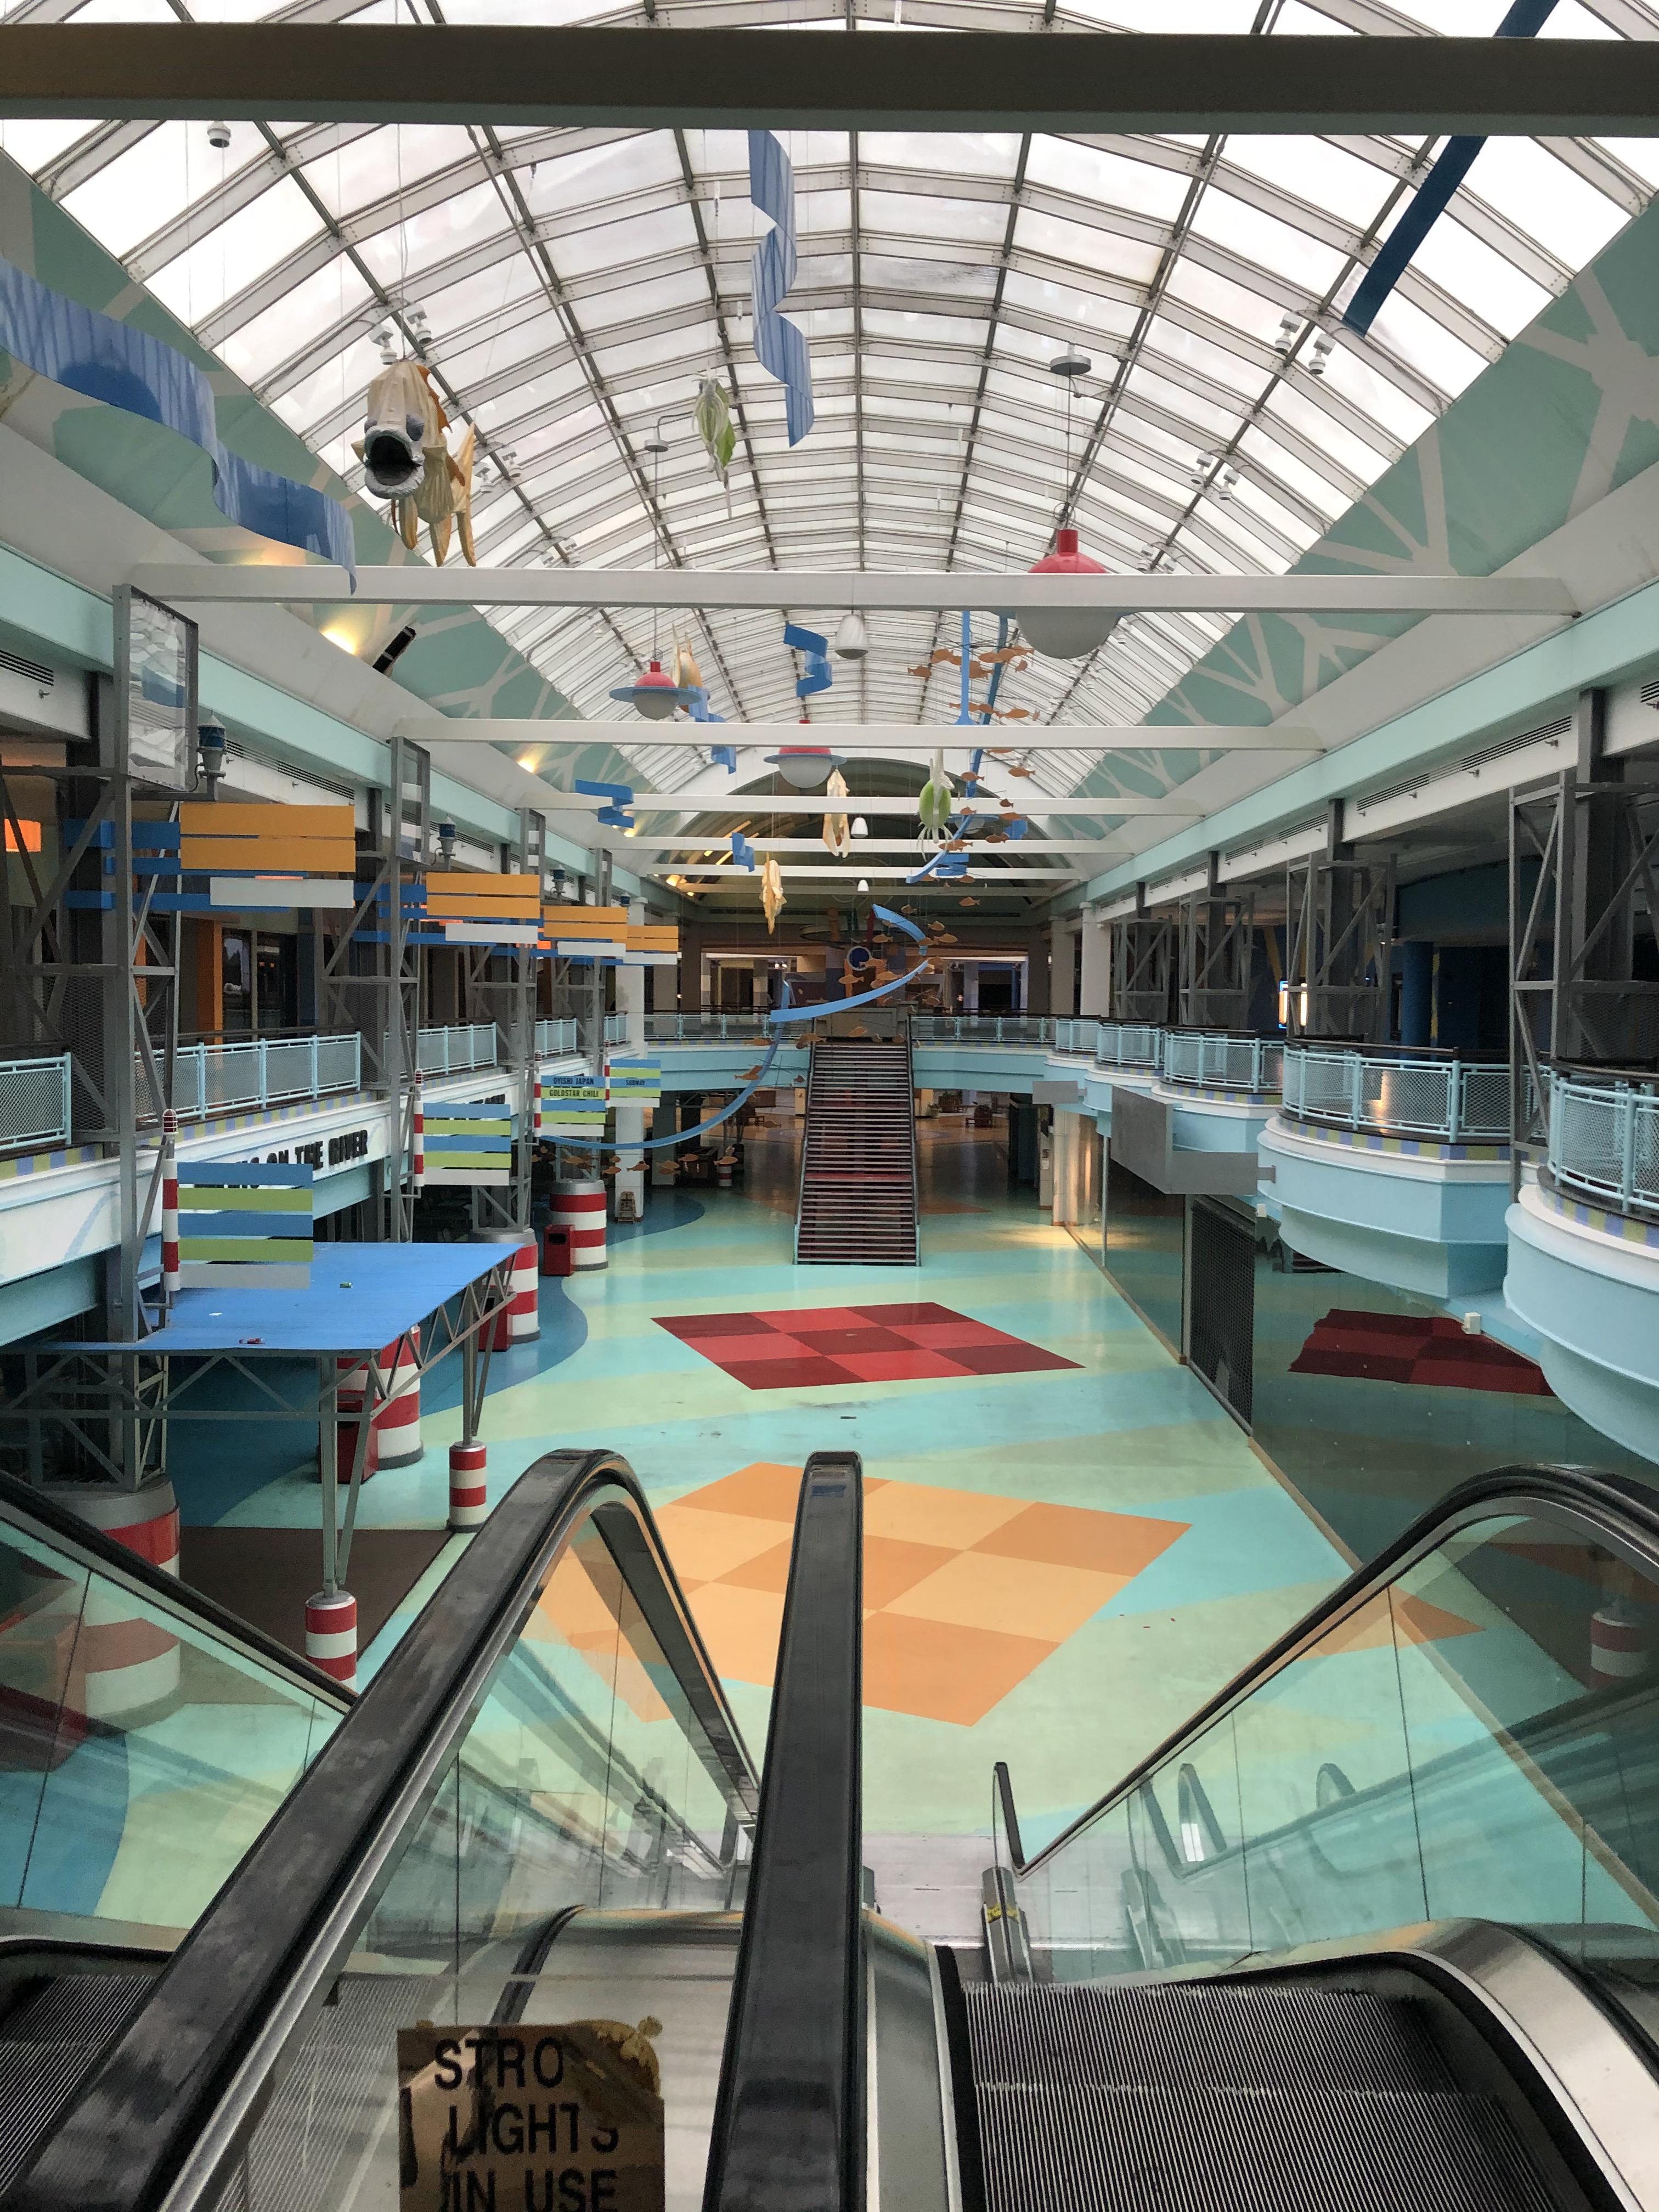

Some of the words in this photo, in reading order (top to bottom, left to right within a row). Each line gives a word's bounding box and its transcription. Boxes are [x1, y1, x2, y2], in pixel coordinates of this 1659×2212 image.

[295, 1141, 323, 1171] THE
[329, 1129, 368, 1166] RIVER
[525, 2168, 617, 2212] USE
